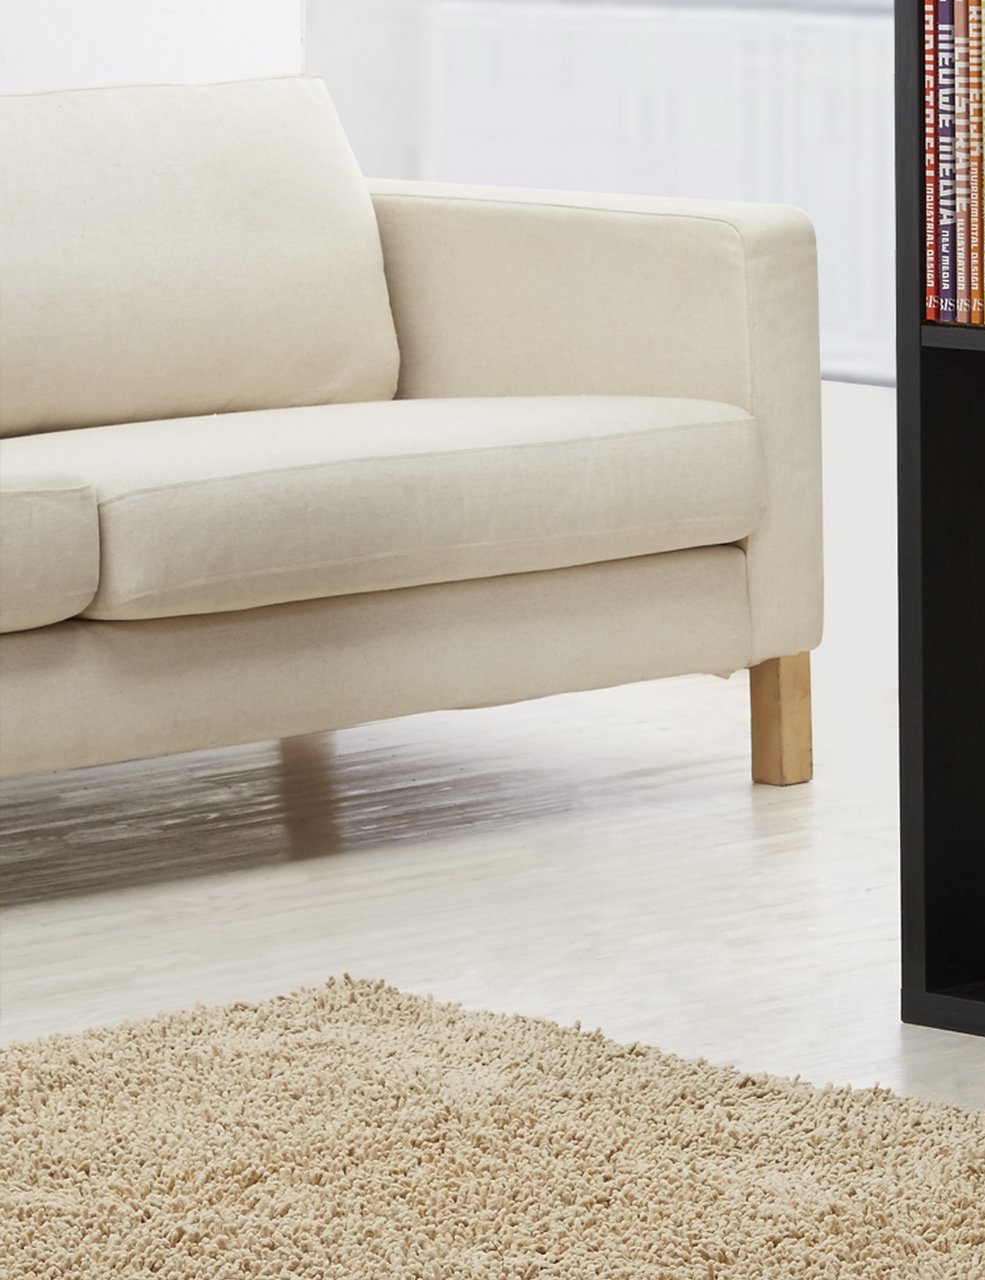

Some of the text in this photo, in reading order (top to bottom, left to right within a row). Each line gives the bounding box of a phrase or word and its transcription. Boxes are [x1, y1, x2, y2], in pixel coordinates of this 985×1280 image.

[941, 231, 950, 290] NEW MEDIA
[956, 218, 967, 291] ILLUSTRATION
